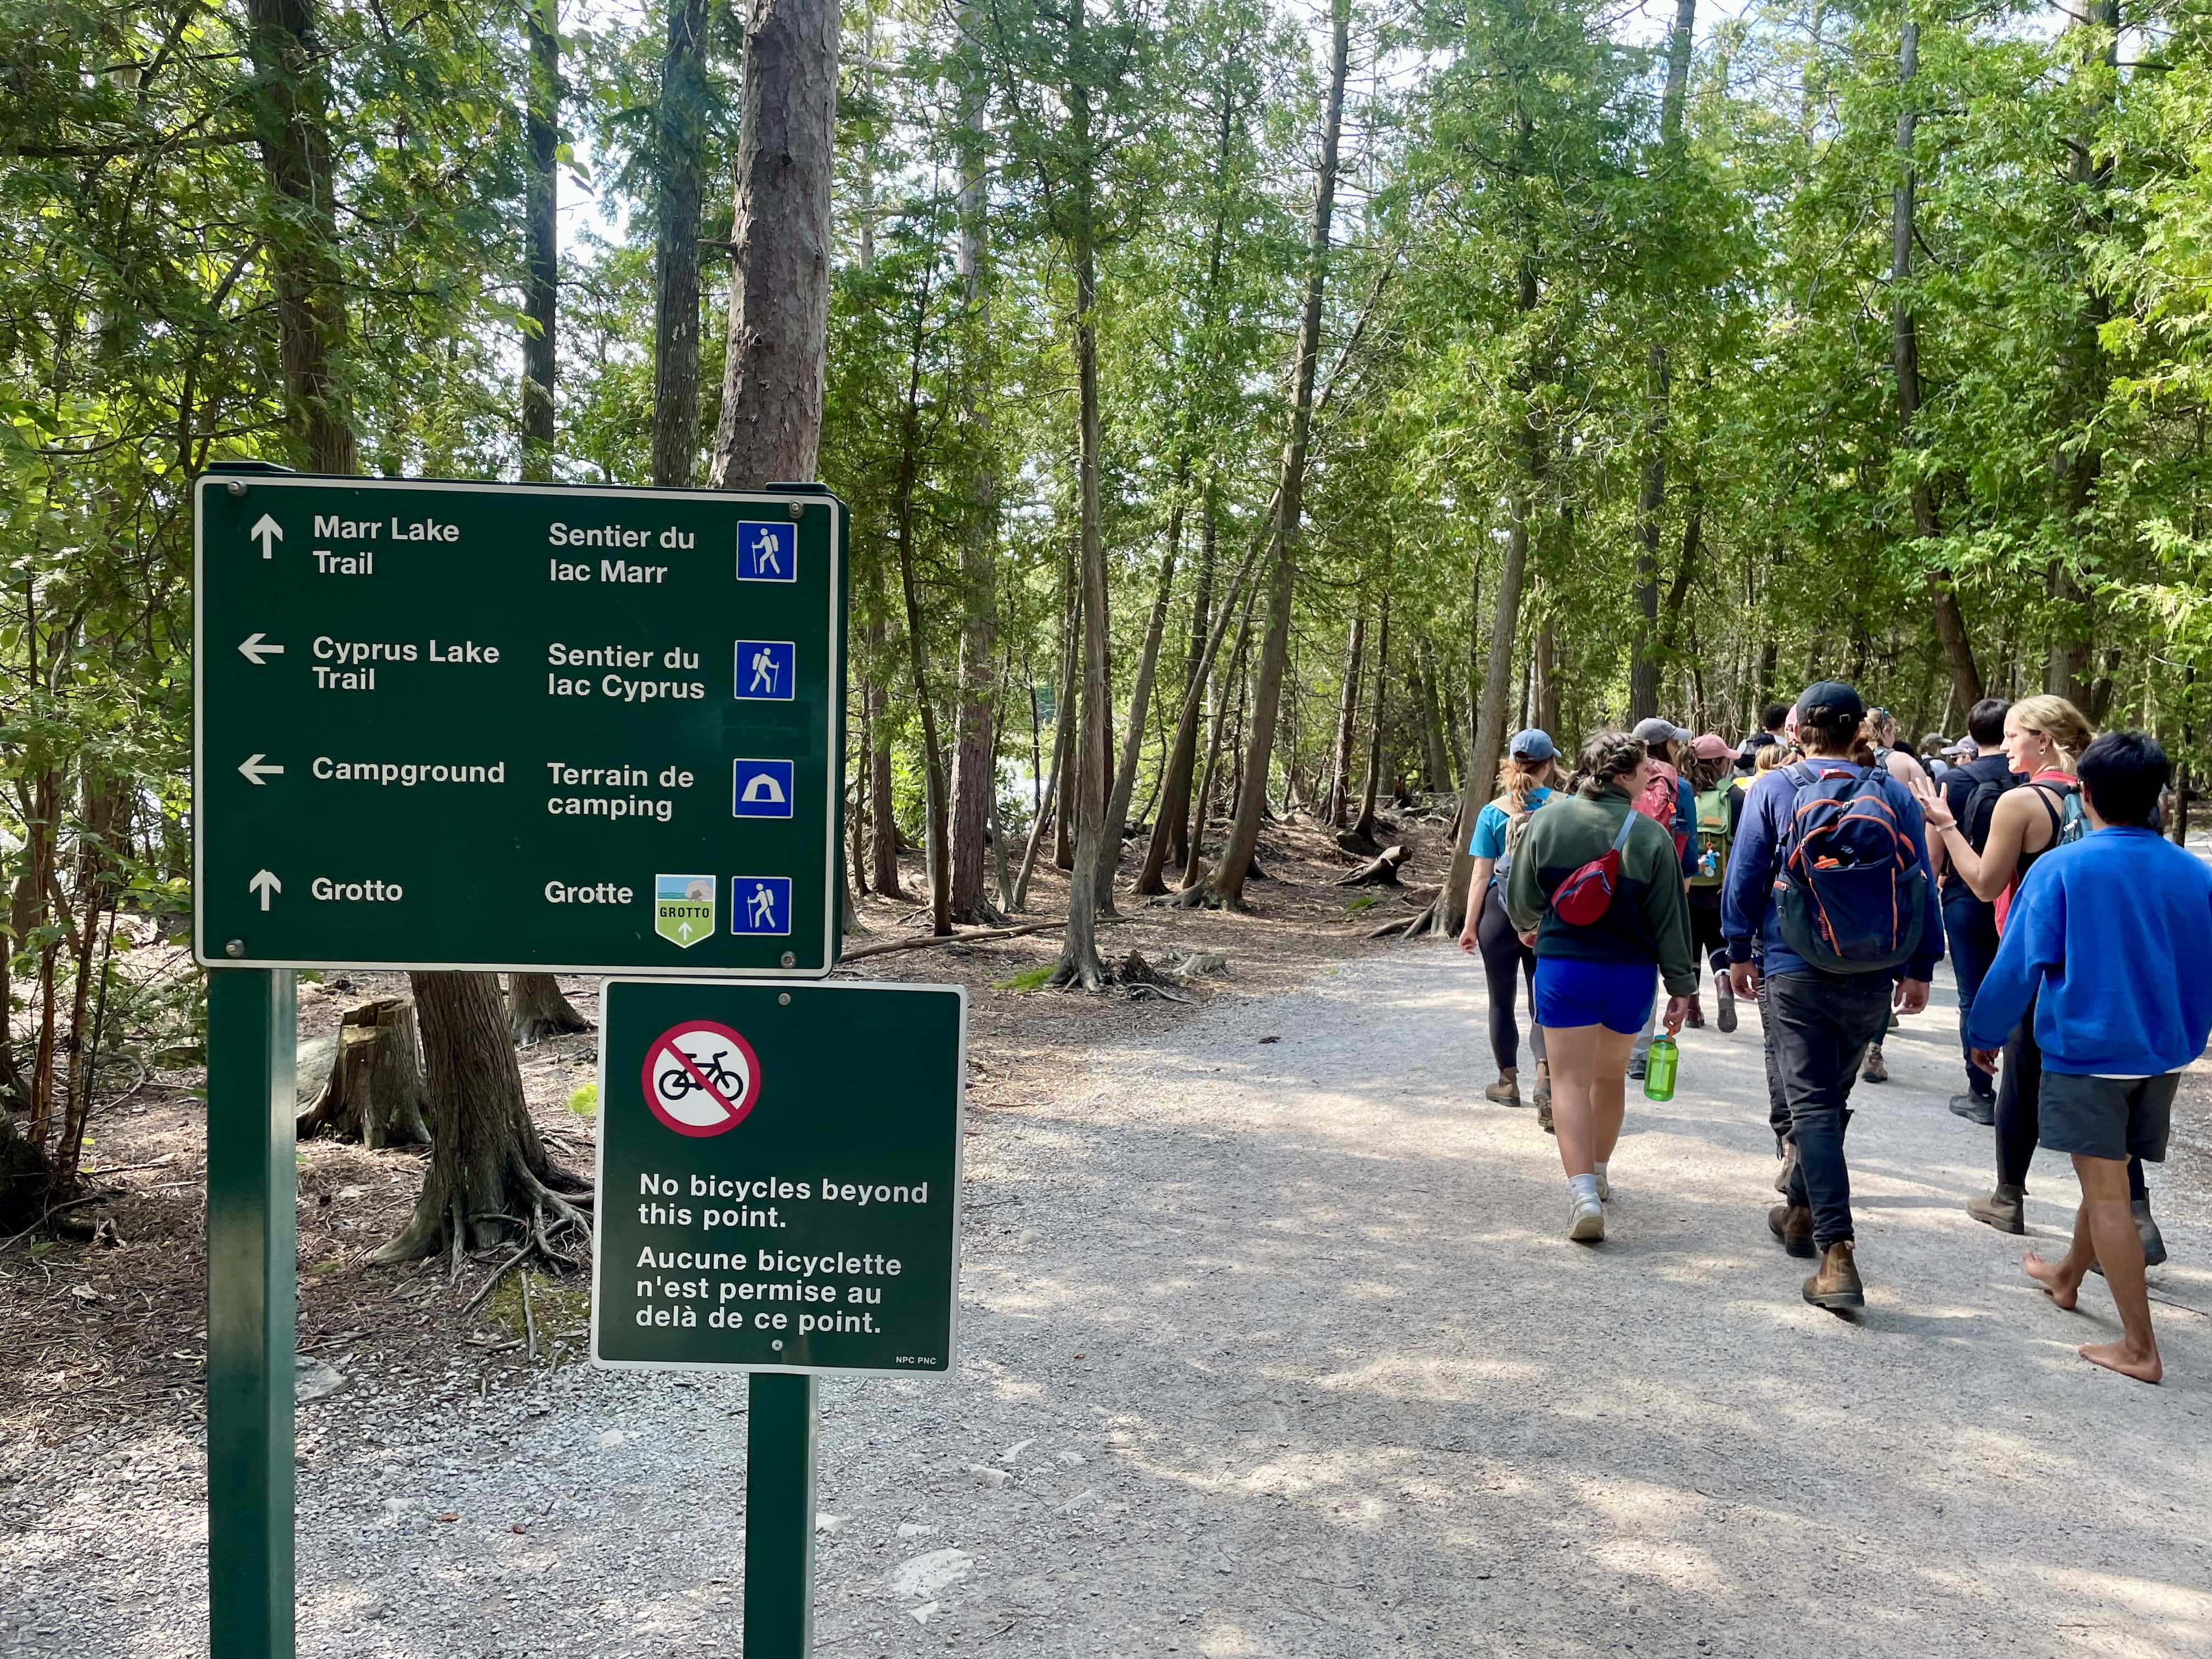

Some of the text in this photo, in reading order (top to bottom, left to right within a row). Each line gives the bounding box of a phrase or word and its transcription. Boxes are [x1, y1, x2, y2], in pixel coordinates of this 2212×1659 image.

[315, 516, 459, 541] Marr Lake
[549, 523, 694, 549] Sentier du
[313, 551, 372, 574] Trail
[551, 559, 667, 583] lac Marr
[314, 636, 499, 664] Cyprus Lake
[549, 644, 698, 669] Sentier du
[313, 667, 374, 689] Trail
[549, 674, 704, 702] lac Cyprus
[313, 757, 504, 786] Campground
[548, 763, 693, 787] Terrain de
[548, 795, 672, 821] camping
[312, 878, 402, 901] Grotto
[545, 881, 633, 903] Grotte
[661, 907, 709, 918] GROTTO
[641, 1173, 927, 1205] No bicycles beyond
[638, 1203, 786, 1230] this point.
[636, 1246, 901, 1277] Aucune bicyclette
[637, 1276, 881, 1304] n'est permise au
[636, 1305, 880, 1335] delà de ce point.
